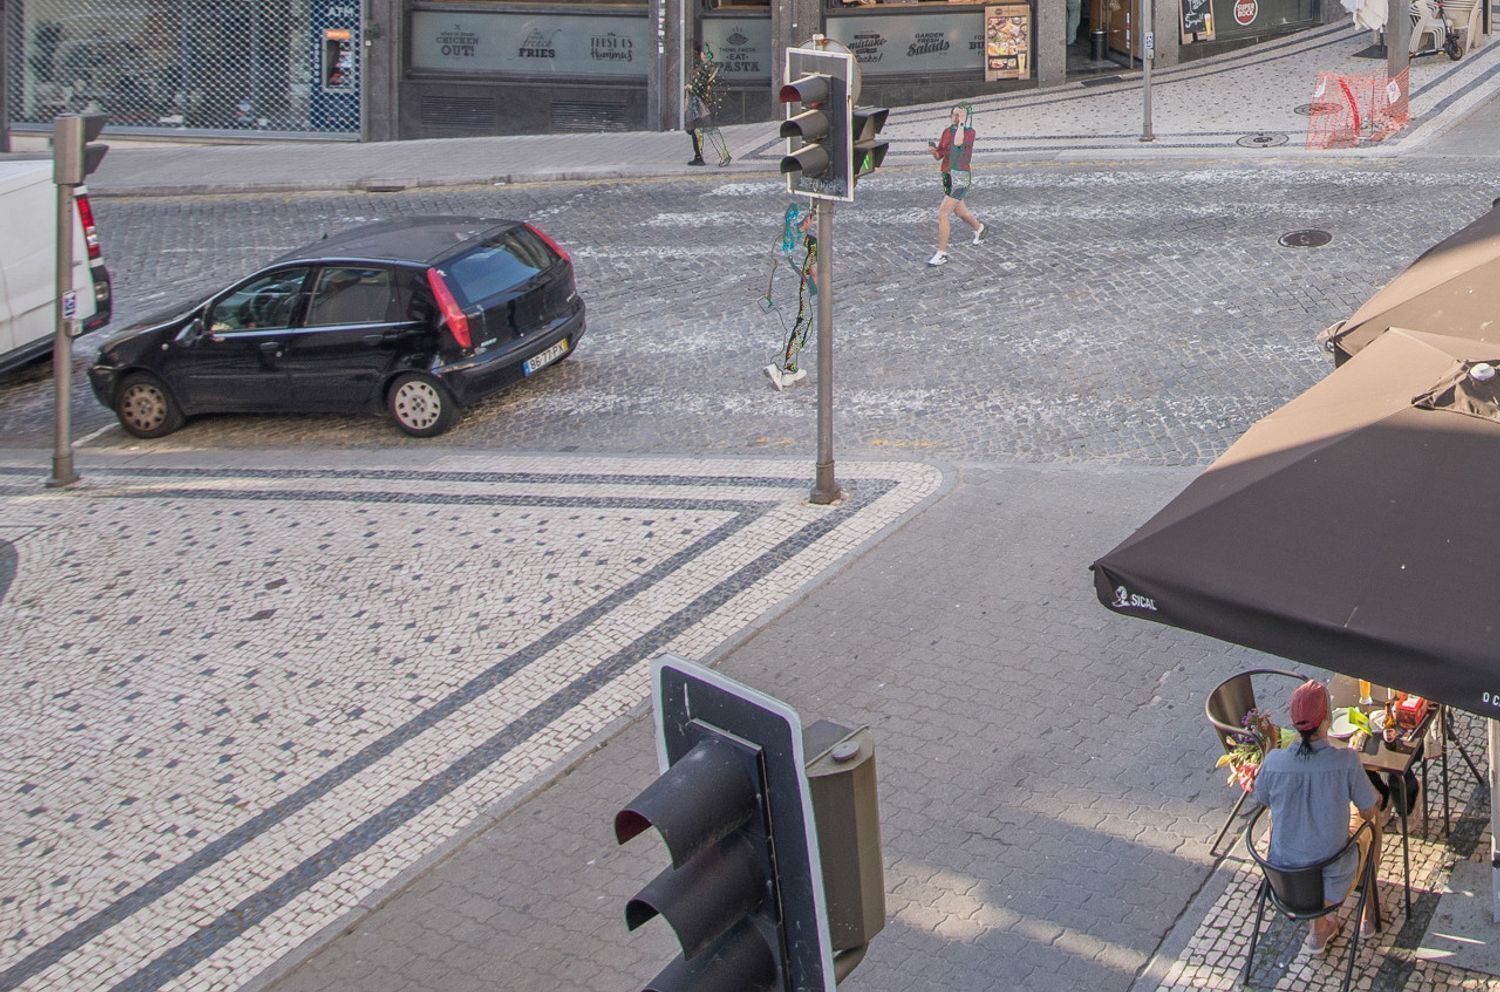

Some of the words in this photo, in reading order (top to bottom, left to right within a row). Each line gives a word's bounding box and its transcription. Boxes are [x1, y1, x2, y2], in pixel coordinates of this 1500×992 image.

[441, 45, 475, 57] OUT!
[519, 48, 556, 58] FRIES
[1483, 692, 1489, 702] O
